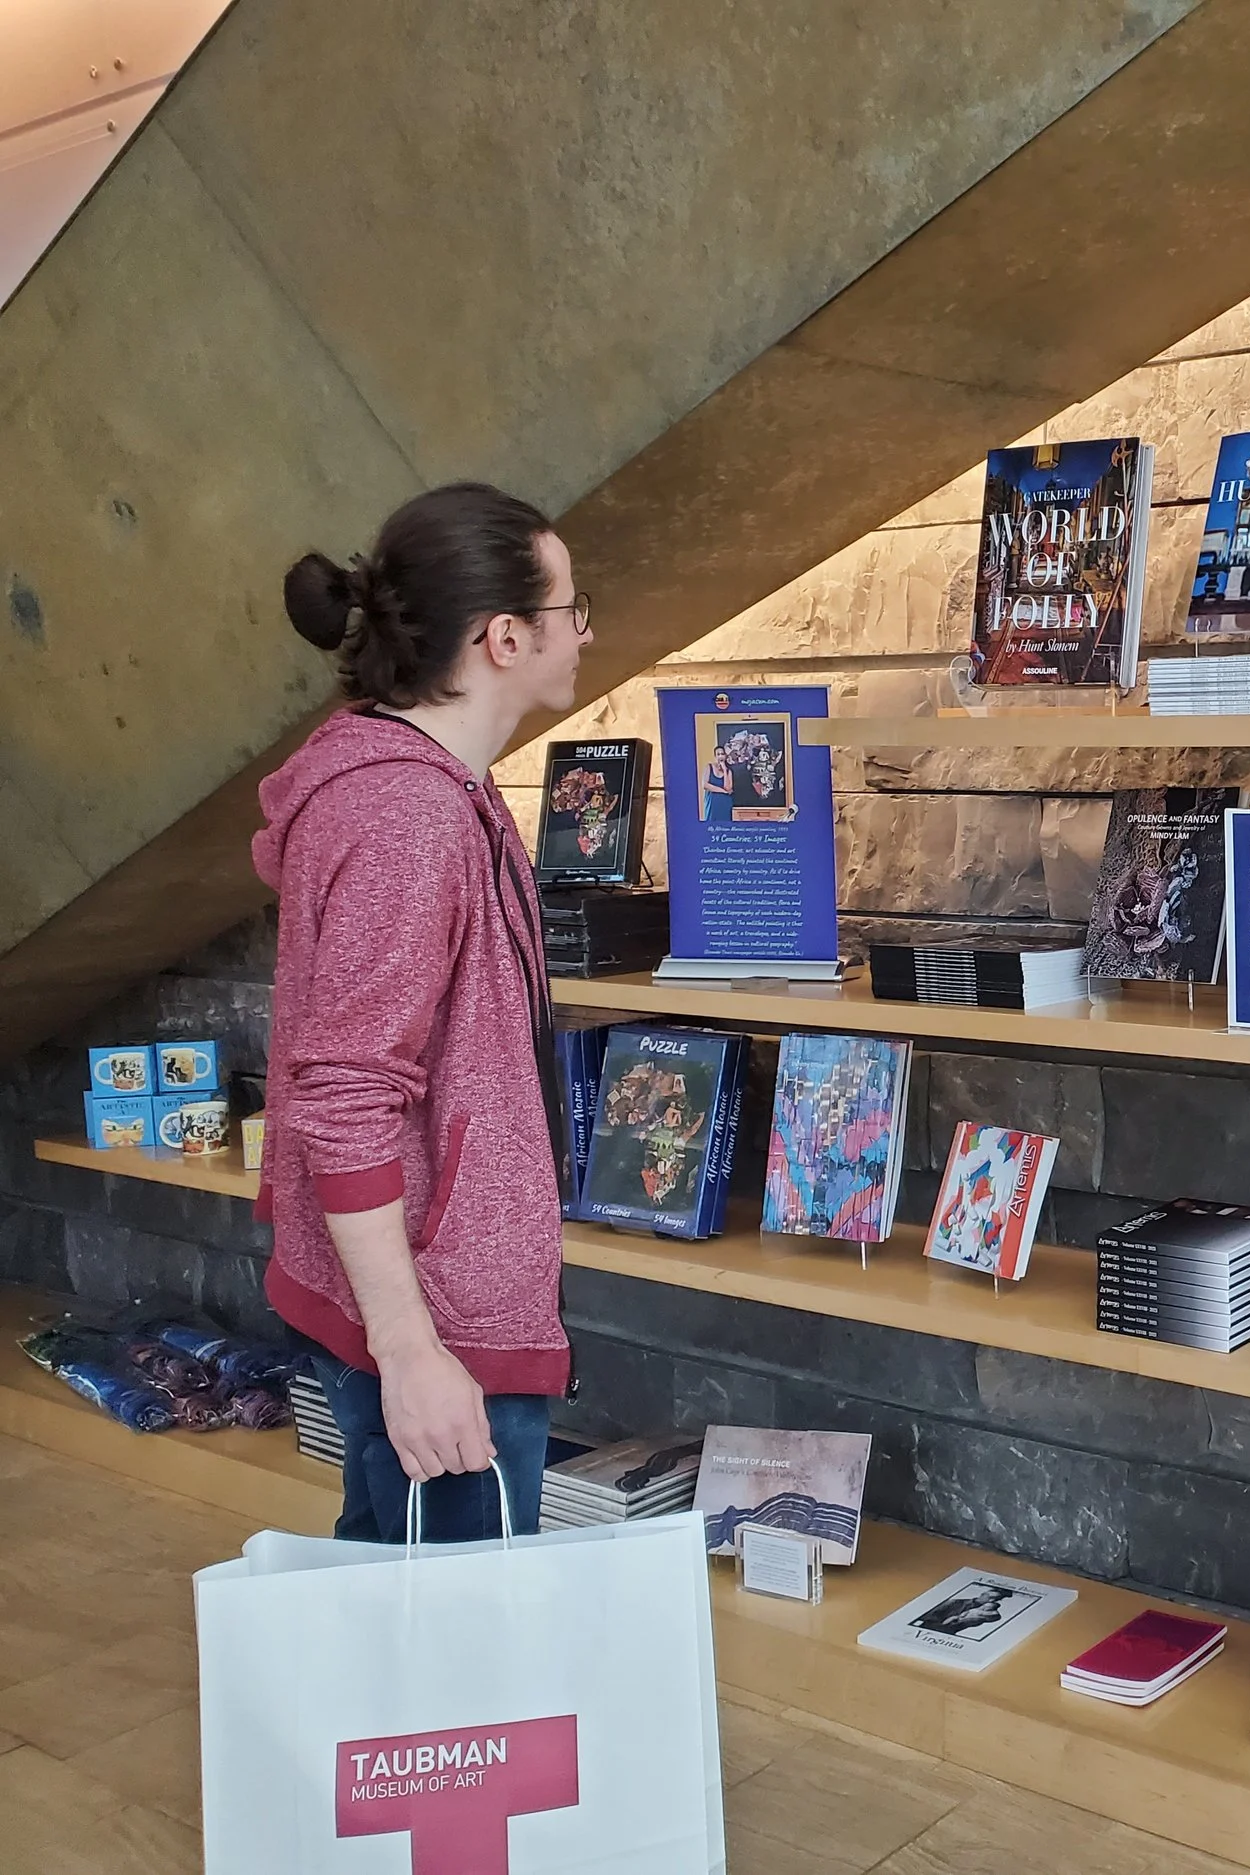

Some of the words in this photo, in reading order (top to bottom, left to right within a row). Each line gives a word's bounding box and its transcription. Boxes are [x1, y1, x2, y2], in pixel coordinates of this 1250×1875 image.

[1023, 488, 1091, 502] GATEKEEPER
[988, 505, 1126, 546] WORLD
[1026, 551, 1076, 588] OF
[993, 593, 1101, 631] FOLLY
[1005, 639, 1017, 658] by
[1019, 639, 1044, 652] Hunt
[1045, 638, 1079, 652] Slonem
[1022, 667, 1058, 675] ASSOULINE
[586, 745, 629, 758] PUZZLE
[1127, 814, 1167, 823] OPULENCE
[1183, 814, 1220, 824] FANTASY
[639, 1036, 687, 1056] PUZZLE
[572, 1081, 584, 1122] Mosaic
[707, 1138, 721, 1184] African
[715, 1091, 728, 1135] Mosaic
[721, 1133, 735, 1179] African
[729, 1087, 743, 1132] Mosaic
[577, 1125, 588, 1168] African
[1007, 1143, 1037, 1217] Artemis
[592, 1203, 601, 1213] 54
[653, 1214, 664, 1223] 54
[664, 1215, 686, 1229] Images
[713, 1455, 725, 1463] THE
[727, 1457, 748, 1465] SIGHT
[761, 1460, 790, 1468] SILENCE
[914, 1630, 964, 1650] Virginia
[350, 1737, 507, 1781] TAUBMAN
[351, 1778, 423, 1802] MUSEUM
[428, 1774, 448, 1792] OF
[454, 1770, 485, 1789] ART
